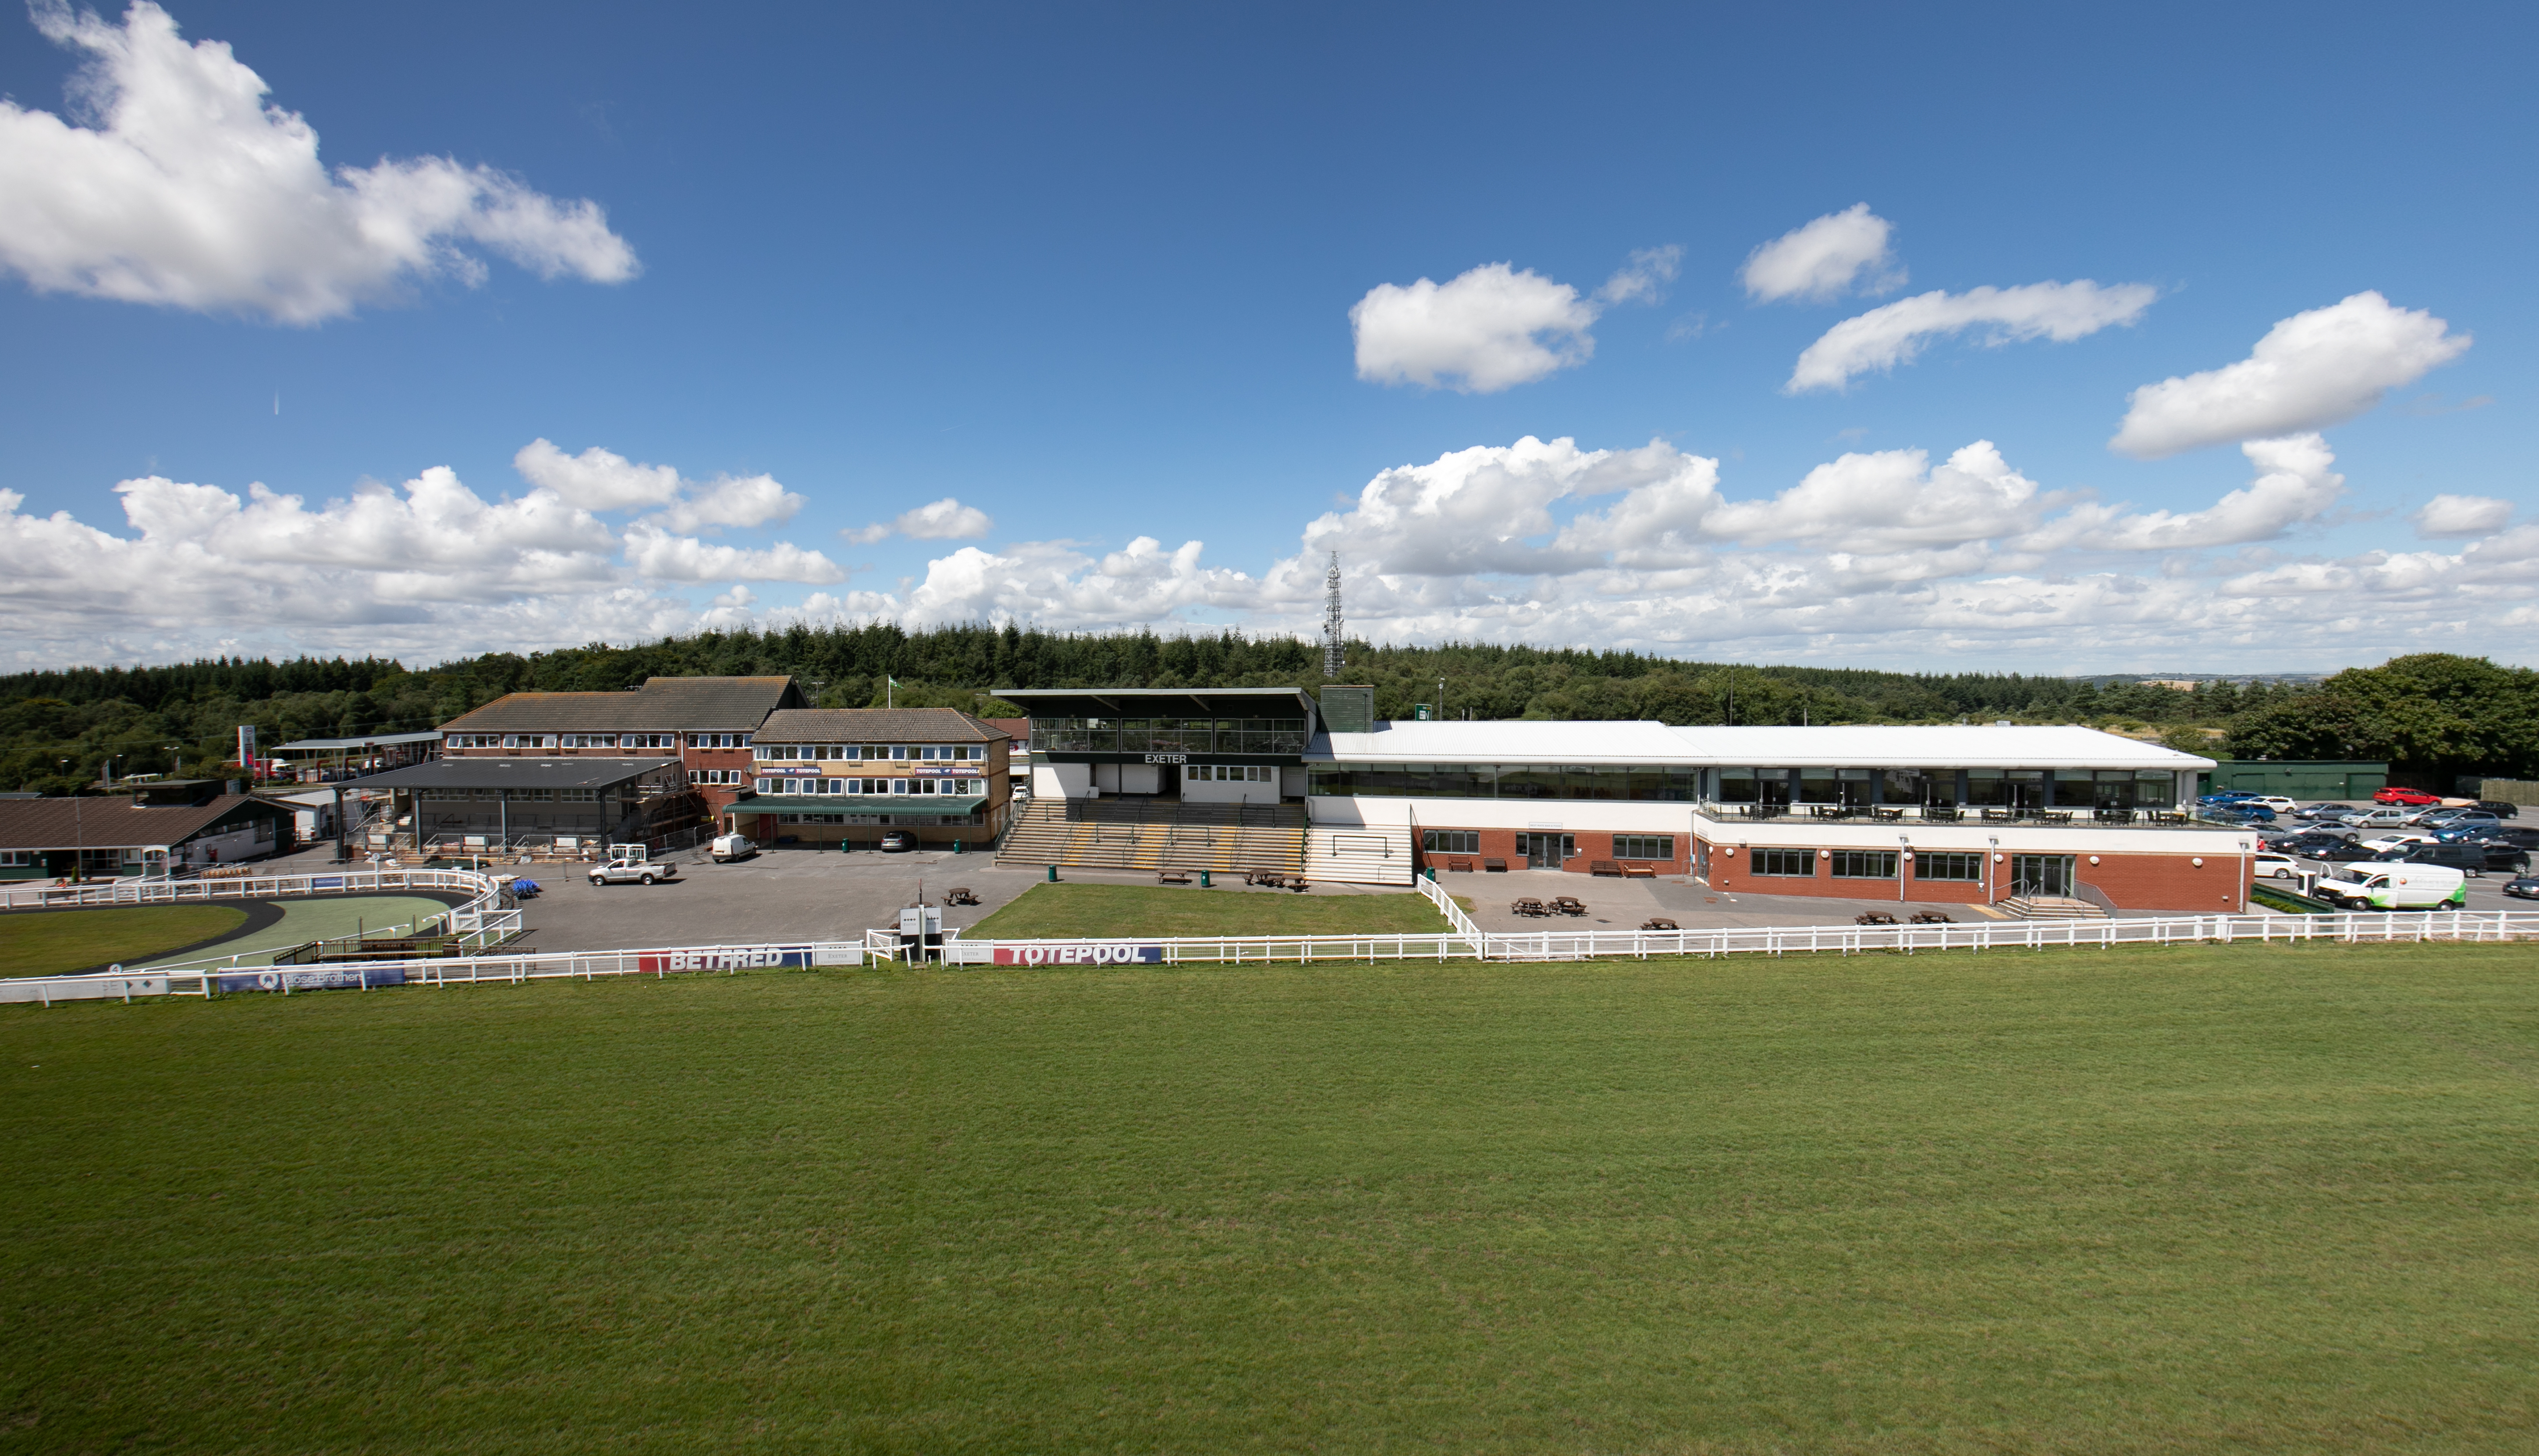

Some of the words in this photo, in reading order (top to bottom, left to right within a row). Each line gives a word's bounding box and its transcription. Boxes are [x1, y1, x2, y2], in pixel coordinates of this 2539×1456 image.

[1145, 754, 1186, 763] EXETER
[669, 948, 783, 970] BETFRED
[1009, 944, 1146, 964] TOTEPOOL
[317, 972, 363, 983] Brothers
